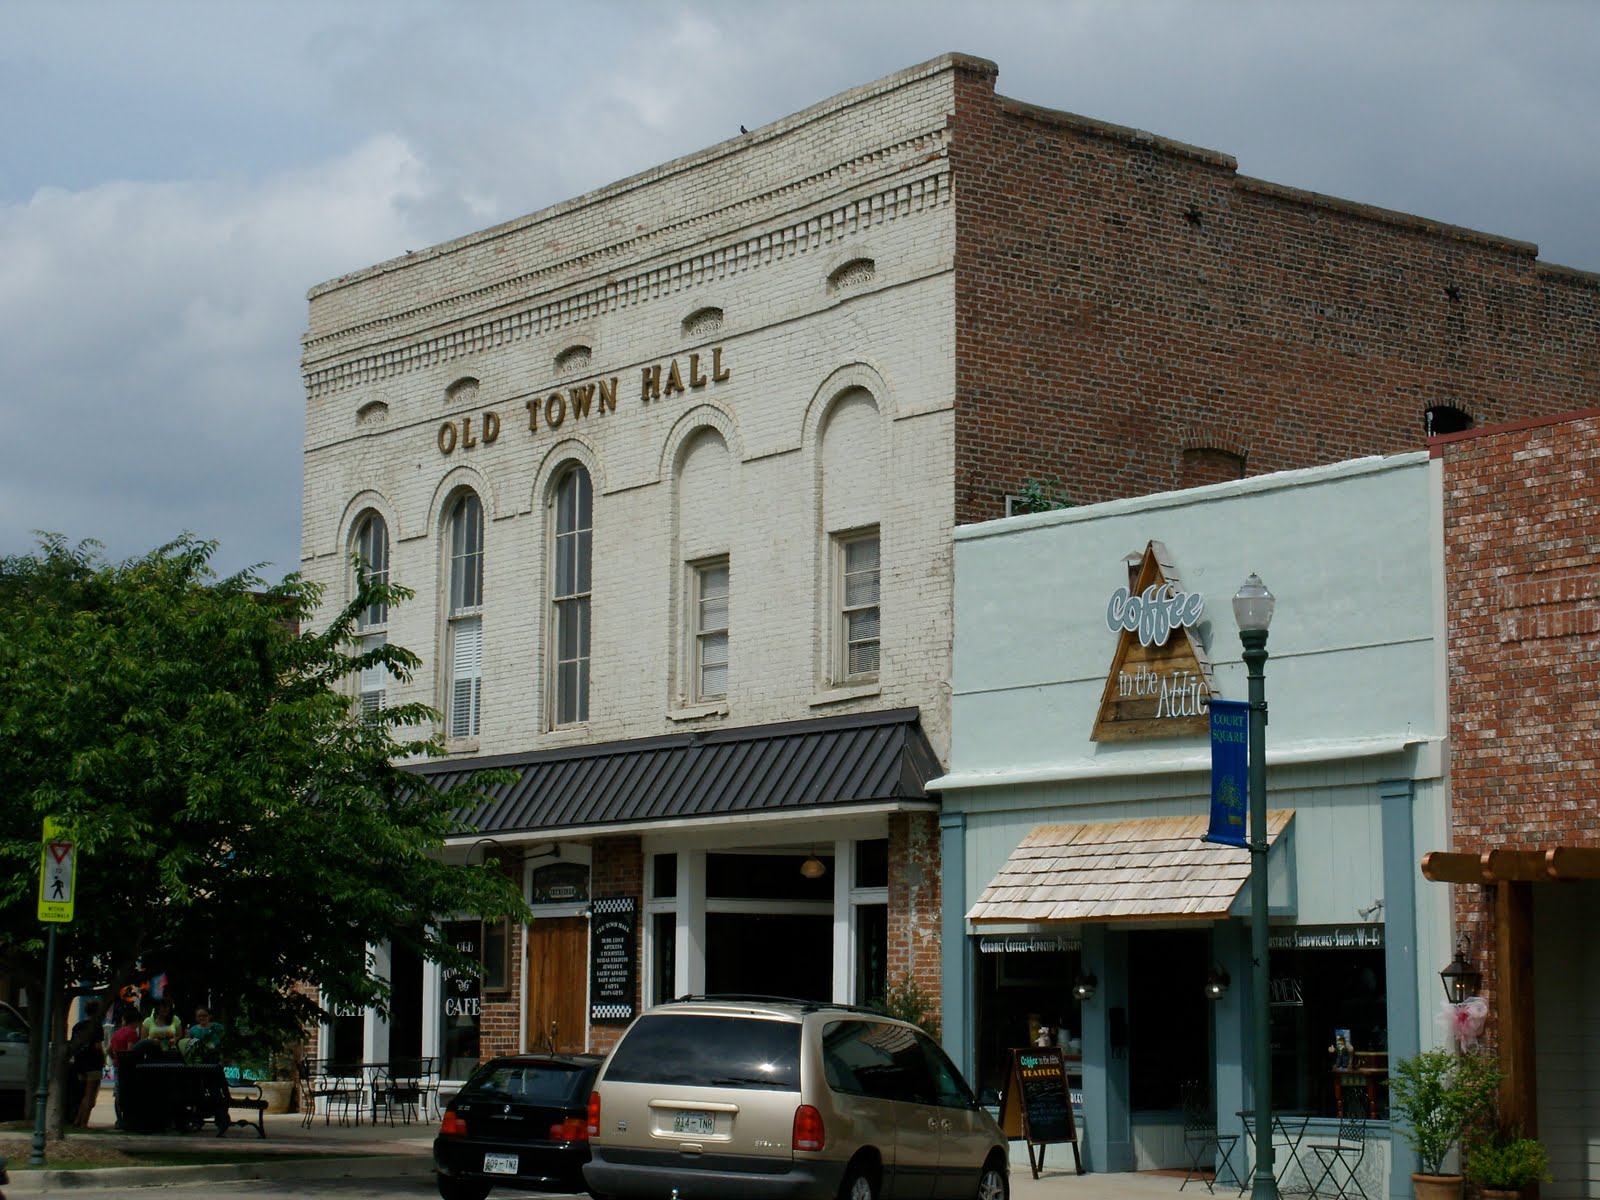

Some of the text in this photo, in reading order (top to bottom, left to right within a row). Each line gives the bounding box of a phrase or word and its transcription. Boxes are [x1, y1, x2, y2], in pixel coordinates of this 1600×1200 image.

[437, 347, 730, 454] OLD TOWN HALL
[1106, 582, 1202, 646] Coffee
[1119, 666, 1208, 718] in the Attic
[1213, 713, 1244, 726] COURT
[1213, 729, 1246, 743] SQUARE
[456, 941, 474, 953] OLD
[445, 997, 481, 1017] CAFE
[1022, 1068, 1061, 1078] FEATURES
